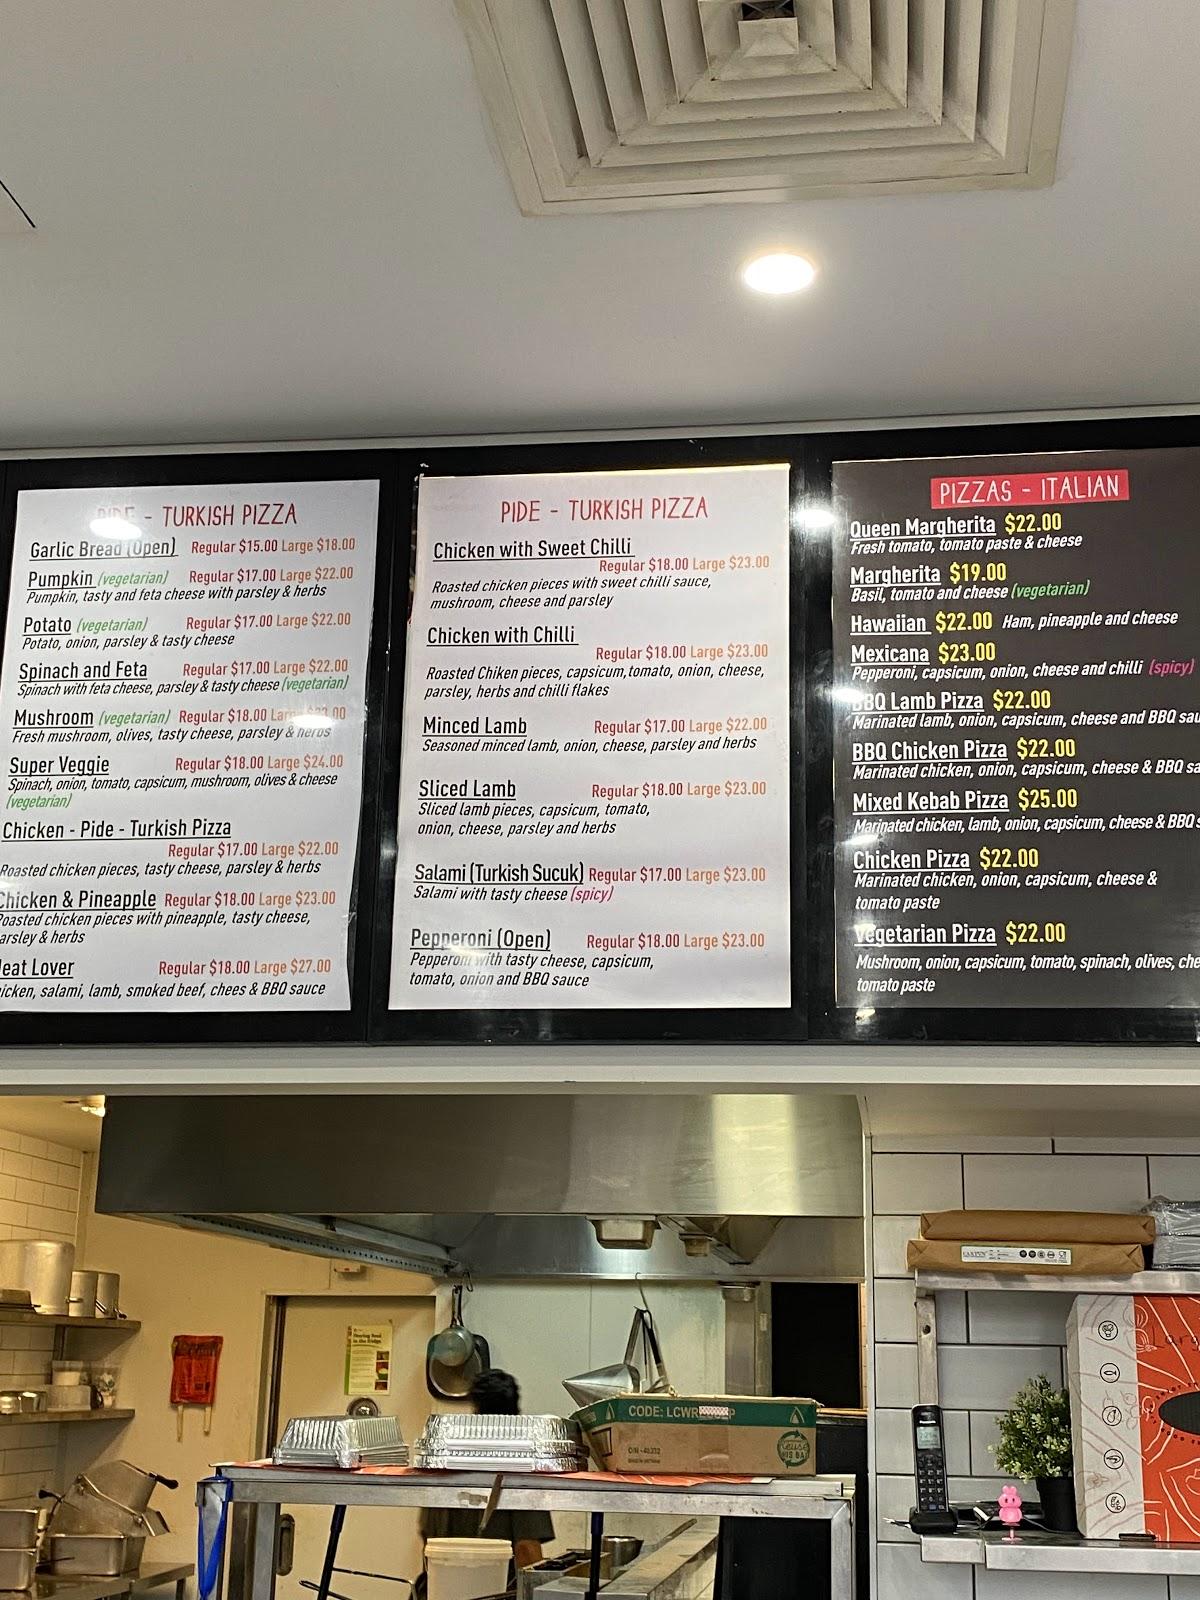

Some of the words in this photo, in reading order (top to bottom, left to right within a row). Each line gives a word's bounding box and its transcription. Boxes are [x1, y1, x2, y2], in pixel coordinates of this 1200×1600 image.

[940, 481, 1011, 505] PIZZAS
[1040, 477, 1121, 500] ITALIAN
[162, 504, 234, 527] TURKISH
[242, 503, 297, 526] PIZZA
[501, 501, 540, 523] PIDE
[568, 499, 642, 521] TURKISH
[652, 497, 708, 520] PIZZA
[850, 519, 902, 537] Queen
[905, 517, 995, 539] Margherita
[1005, 513, 1061, 534] $22.00
[30, 541, 74, 559] Garlic
[79, 540, 121, 558] Bread
[127, 538, 175, 560] (Open)
[191, 540, 236, 557] Regular
[239, 539, 278, 553] $15.00
[281, 539, 313, 555] Large
[317, 538, 355, 552] $18.00
[434, 541, 494, 559] Chicken
[499, 540, 532, 557] with
[538, 539, 585, 556] Sweet
[590, 538, 630, 555] Chilli
[850, 541, 886, 554] Fresh
[885, 539, 935, 555] tomato,
[939, 538, 984, 552] tomato
[985, 537, 1022, 553] paste
[1024, 536, 1034, 549] &
[1036, 535, 1082, 549] cheese
[599, 558, 645, 575] Regular
[648, 557, 688, 571] $18.00
[693, 556, 725, 572] Large
[729, 555, 769, 569] $23.00
[850, 566, 940, 587] Margherita
[949, 563, 1006, 583] $19.00
[28, 570, 92, 591] Pumpkin
[97, 571, 169, 589] (vegetarian)
[189, 569, 234, 586] Regular
[237, 568, 276, 582] $17.00
[280, 568, 311, 584] Large
[314, 567, 353, 581] $22.00
[431, 580, 481, 594] Roasted
[481, 579, 528, 593] chicken
[529, 578, 569, 594] pieces
[572, 577, 598, 590] with
[600, 576, 637, 589] sweet
[639, 575, 671, 588] chilli
[673, 577, 710, 589] sauce,
[26, 591, 78, 606] Pumpkin,
[83, 590, 113, 605] tasty
[114, 589, 137, 602] and
[138, 589, 161, 601] feta
[164, 587, 205, 600] cheese
[208, 587, 233, 599] with
[235, 585, 280, 601] parsley
[281, 585, 291, 597] &
[292, 584, 327, 597] herbs
[430, 597, 494, 611] mushroom,
[499, 596, 541, 608] cheese
[543, 595, 566, 607] and
[568, 594, 614, 609] parsley
[849, 588, 887, 604] Basil,
[889, 587, 935, 601] tomato
[937, 585, 962, 600] and
[963, 585, 1008, 599] cheese
[1010, 580, 1090, 600] (vegetarian)
[24, 616, 71, 634] Potato
[76, 617, 148, 635] (vegetarian)
[851, 614, 927, 633] Hawaiian
[935, 612, 992, 632] $22.00
[1001, 615, 1035, 631] Ham,
[1038, 613, 1102, 631] pineapple
[1104, 613, 1130, 627] and
[1131, 611, 1178, 626] cheese
[22, 637, 61, 652] Potato,
[65, 636, 99, 651] onion,
[103, 635, 148, 650] parsley
[149, 635, 158, 647] &
[162, 634, 192, 649] tasty
[193, 633, 235, 646] cheese
[427, 627, 490, 645] Chicken
[494, 626, 530, 644] with
[533, 626, 575, 643] Chilli
[851, 644, 929, 663] Mexicana
[938, 643, 995, 663] $23.00
[19, 663, 78, 684] Spinach
[83, 662, 110, 679] and
[116, 661, 147, 678] Feta
[852, 666, 918, 684] Pepperoni,
[920, 665, 986, 682] capsicum,
[988, 664, 1028, 680] onion,
[1032, 663, 1079, 677] cheese
[1081, 662, 1109, 676] and
[1108, 661, 1143, 676] chilli
[1148, 660, 1195, 677] (spicy)
[423, 717, 479, 735] Minced
[485, 716, 526, 734] Lamb
[594, 720, 641, 737] Regular
[644, 719, 684, 733] $17.00
[689, 719, 722, 735] Large
[726, 718, 766, 732] $22.00
[852, 743, 889, 762] BBQ
[891, 742, 958, 761] Chicken
[963, 741, 1007, 760] Pizza
[1017, 739, 1075, 759] $22.00
[9, 757, 54, 778] Super
[59, 756, 109, 777] Veggie
[175, 757, 221, 774] Regular
[224, 757, 263, 771] $18.00
[267, 756, 299, 772] Large
[303, 755, 343, 769] $24.00
[419, 779, 467, 797] Sliced
[473, 779, 515, 797] Lamb
[418, 803, 457, 817] Sliced
[459, 803, 490, 816] lamb
[492, 803, 534, 819] pieces,
[539, 802, 599, 818] capsicum,
[605, 802, 649, 817] tomato,
[853, 793, 902, 812] Mixed
[908, 792, 960, 811] Kebab
[965, 791, 1008, 810] Pizza
[1018, 789, 1077, 809] $25.00
[3, 822, 63, 839] Chicken
[80, 821, 113, 838] Pide
[130, 820, 186, 837] Turkish
[192, 819, 230, 836] Pizza
[853, 850, 921, 869] Chicken
[926, 849, 969, 868] Pizza
[979, 849, 1038, 868] $22.00
[414, 863, 466, 881] Salami
[470, 864, 528, 885] (Turkish
[532, 864, 583, 885] Sucuk)
[589, 869, 637, 885] Regular
[640, 869, 681, 882] $17.00
[686, 869, 719, 885] Large
[724, 868, 765, 882] $23.00
[413, 887, 458, 900] Salami
[460, 887, 487, 900] with
[490, 888, 522, 903] tasty
[524, 888, 568, 901] cheese
[570, 887, 614, 903] (spicy)
[628, 1405, 664, 1417] CODE:
